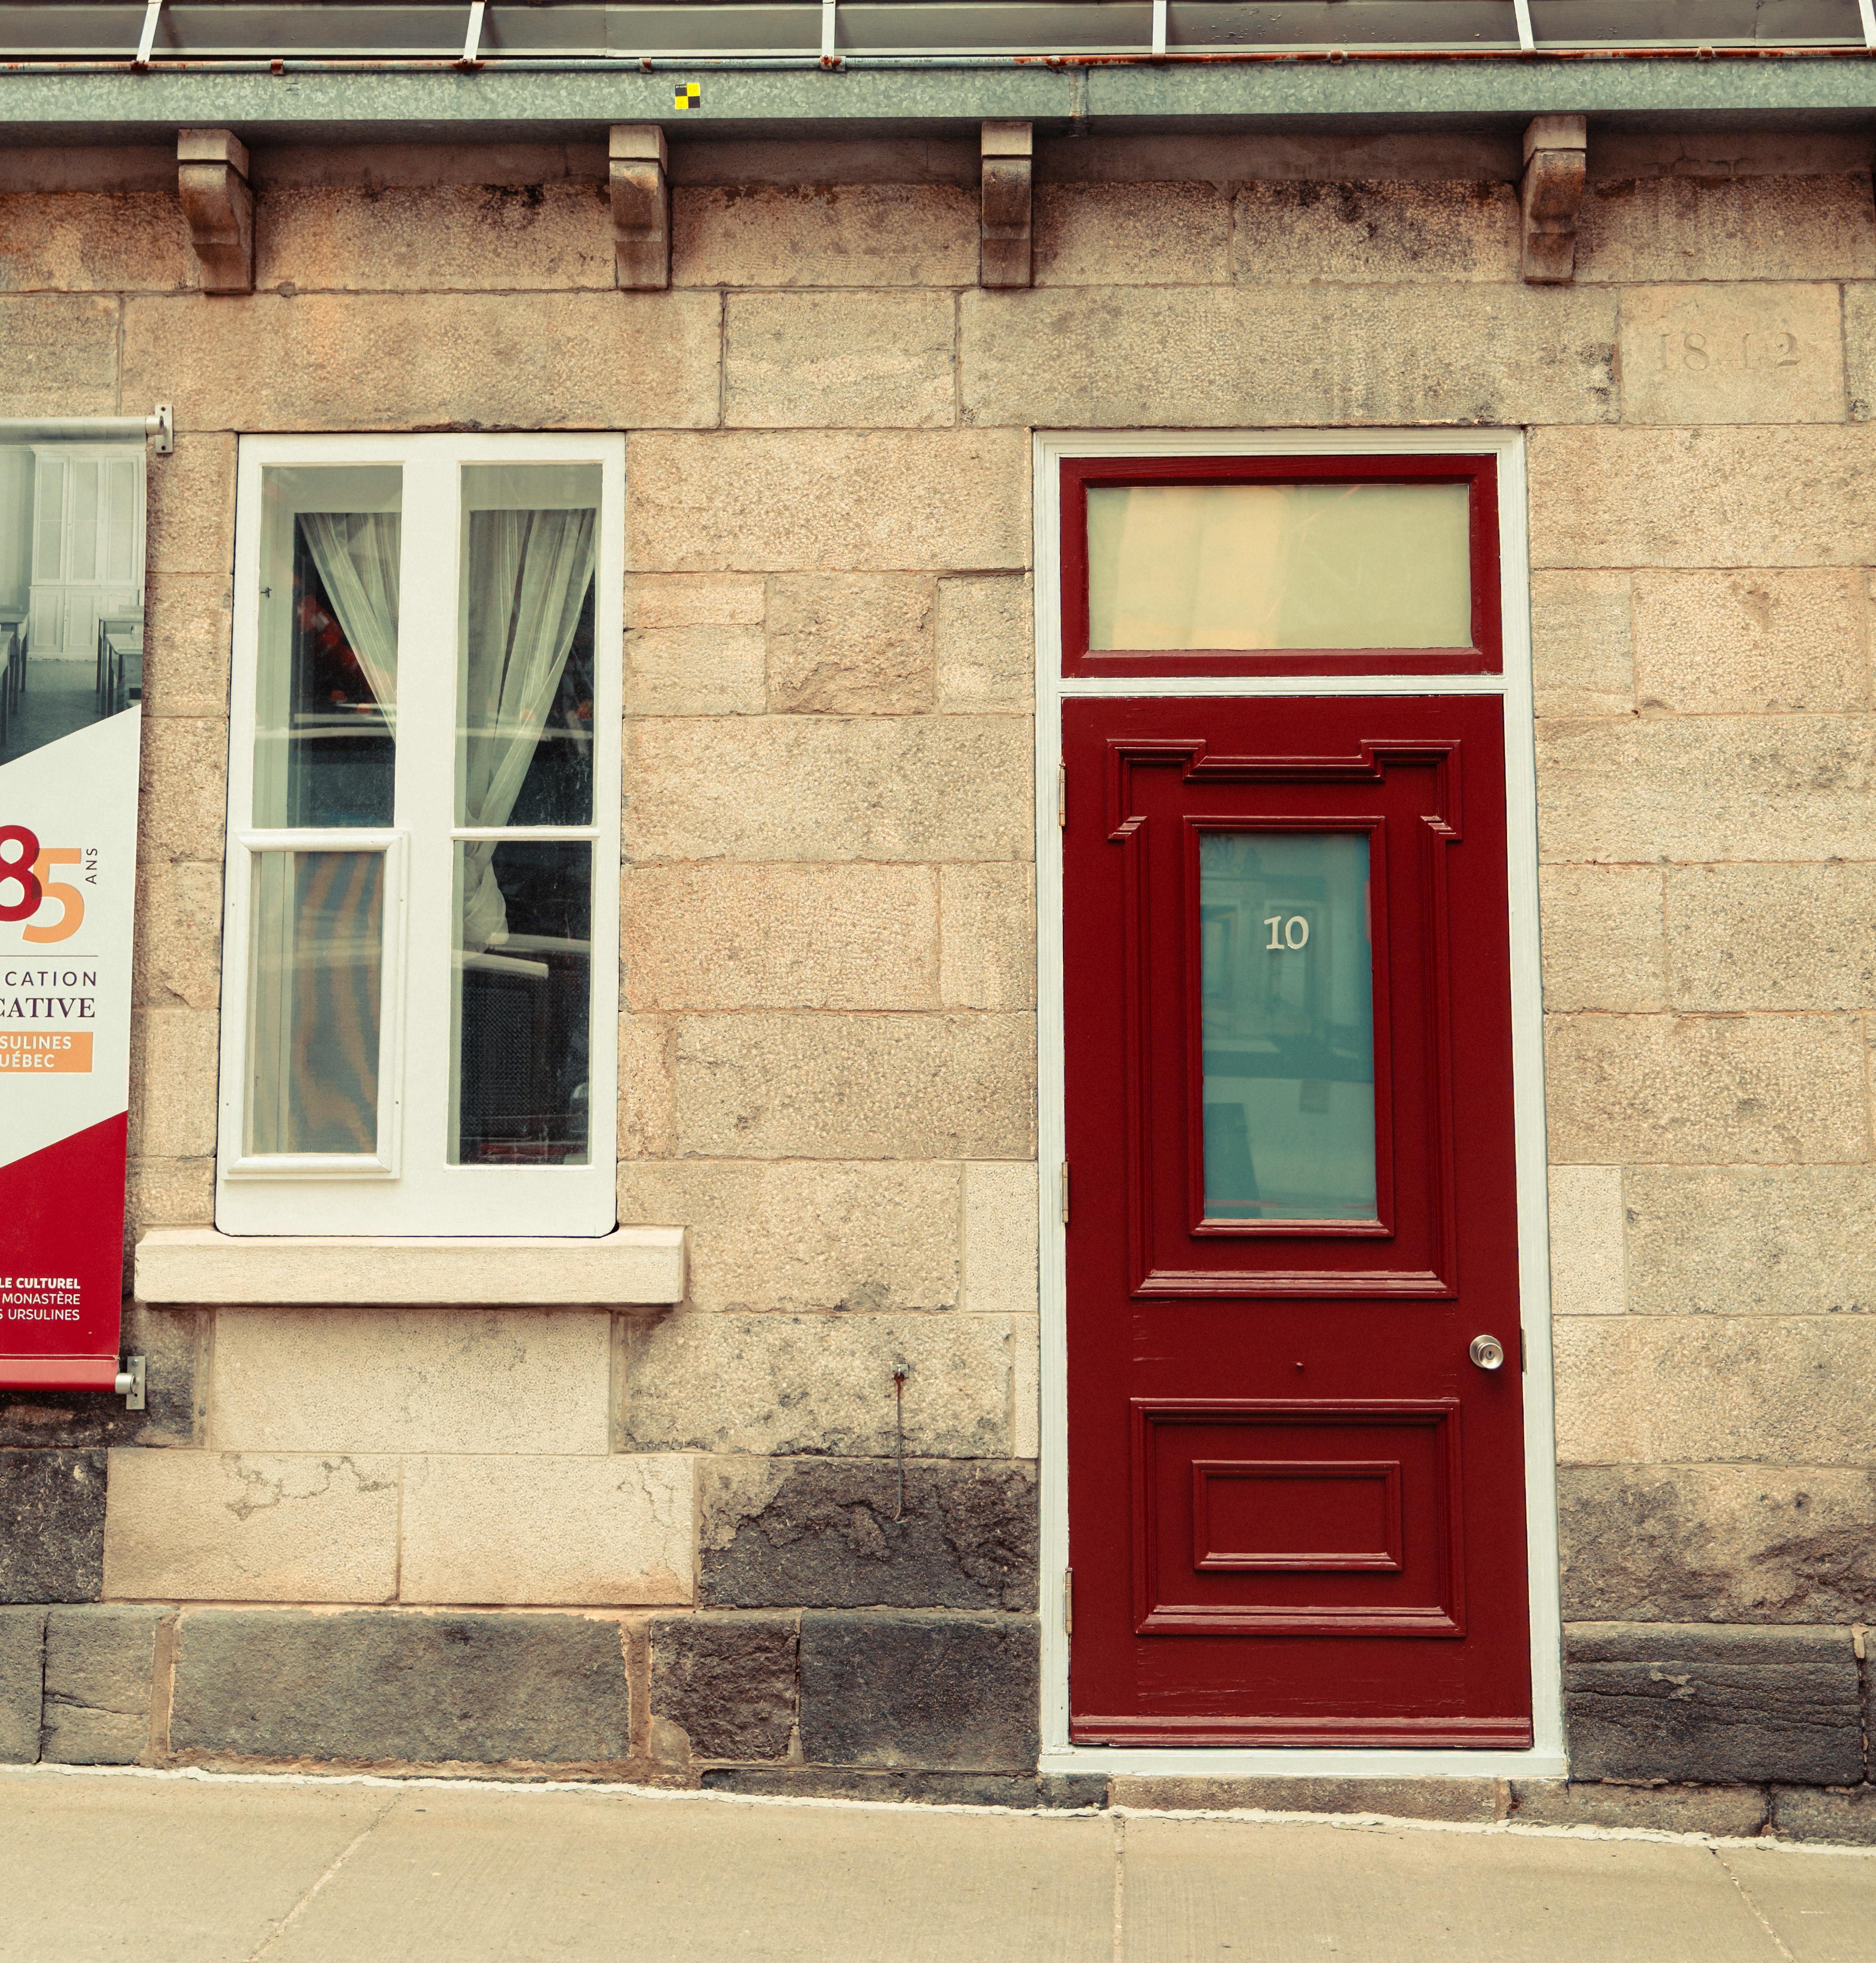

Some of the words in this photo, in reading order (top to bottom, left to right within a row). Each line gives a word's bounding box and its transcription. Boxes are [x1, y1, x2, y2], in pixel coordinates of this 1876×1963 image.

[1655, 332, 1802, 372] 1842
[85, 848, 98, 884] ANS
[0, 824, 85, 944] 85
[1264, 916, 1309, 949] 10
[5, 971, 96, 986] CATION
[0, 1035, 71, 1049] SULINES
[0, 1050, 55, 1067] UÉBEC
[16, 1277, 81, 1289] CULTUREL
[2, 1291, 81, 1305] MONASTÈRE
[8, 1308, 80, 1321] URSULINES
